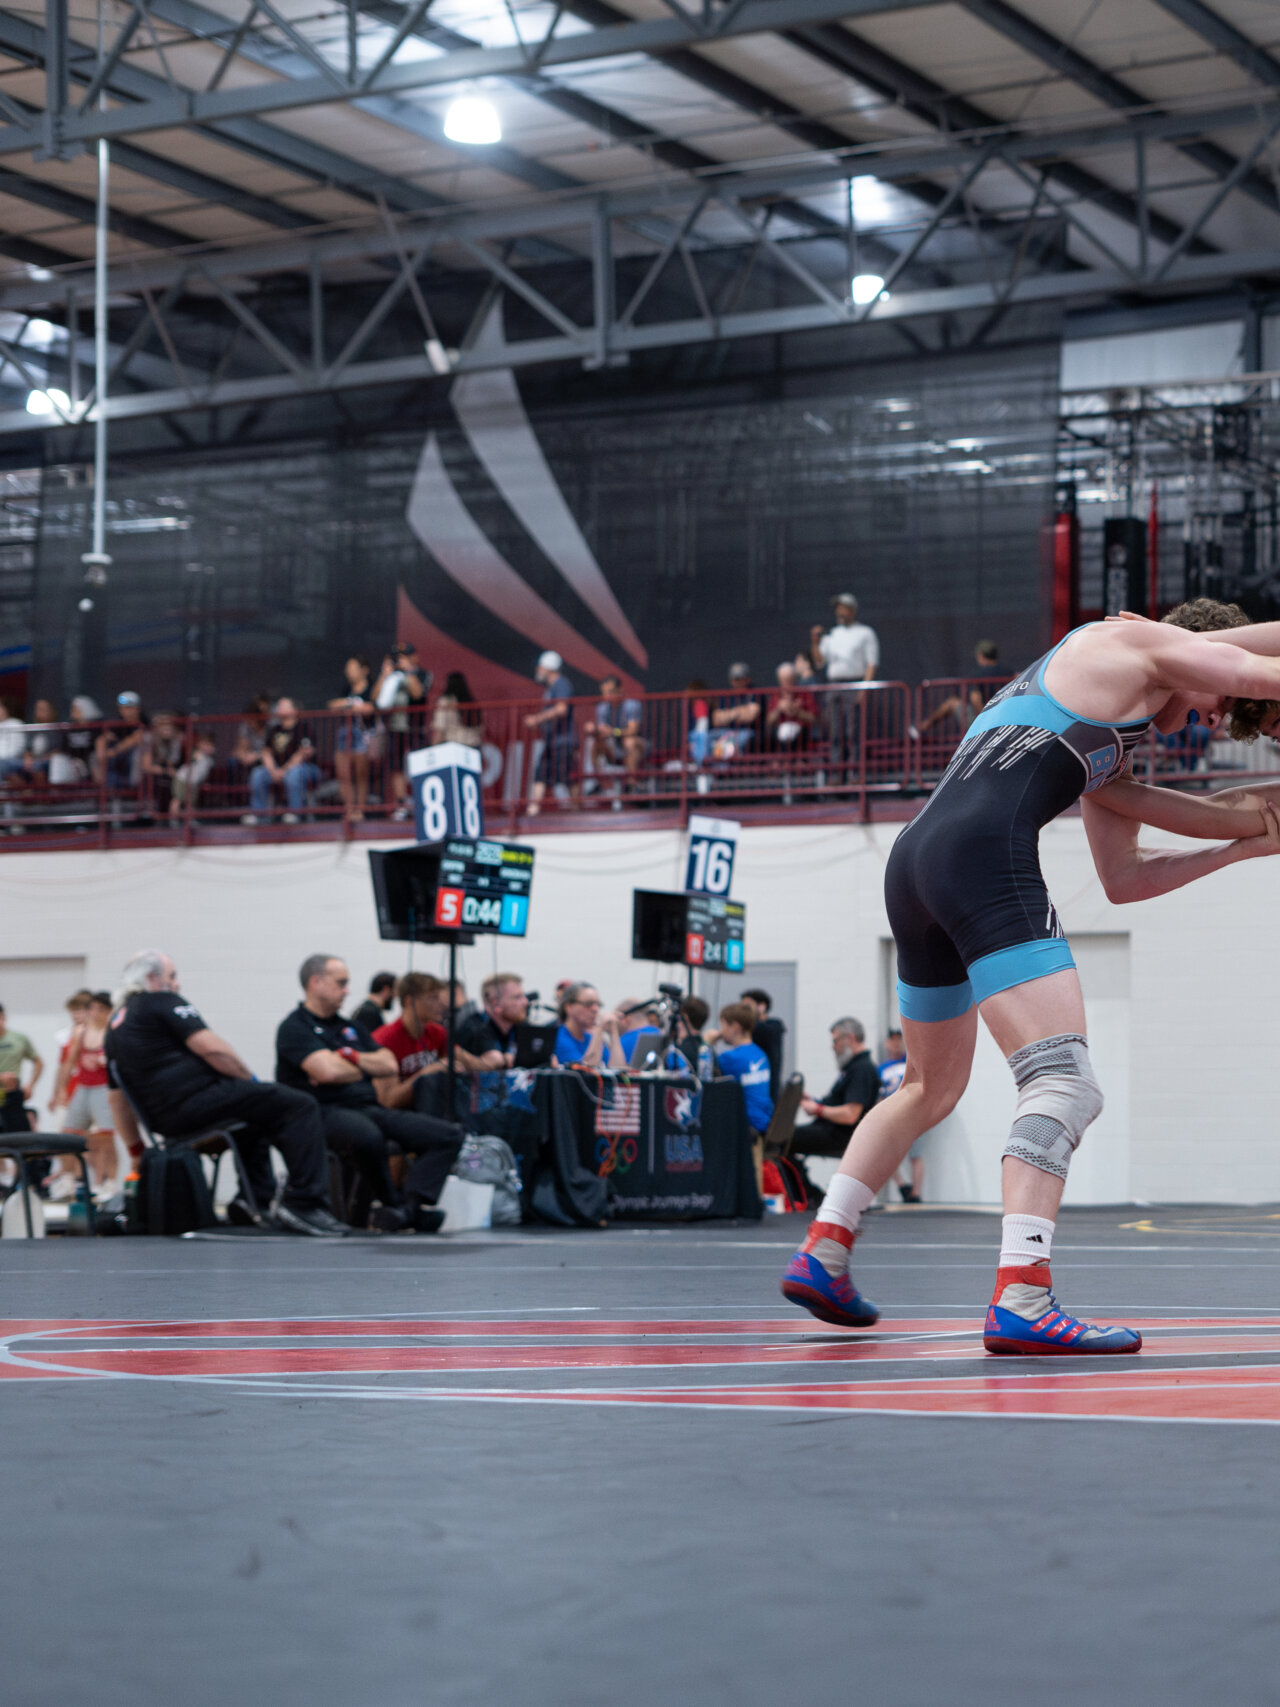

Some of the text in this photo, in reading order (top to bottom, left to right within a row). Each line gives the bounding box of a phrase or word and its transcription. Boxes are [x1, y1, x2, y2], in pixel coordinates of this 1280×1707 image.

[421, 775, 448, 840] 8
[462, 774, 480, 838] 8
[691, 840, 732, 894] 16
[440, 893, 458, 922] 5
[462, 896, 502, 926] 0:44
[664, 1134, 704, 1162] USA
